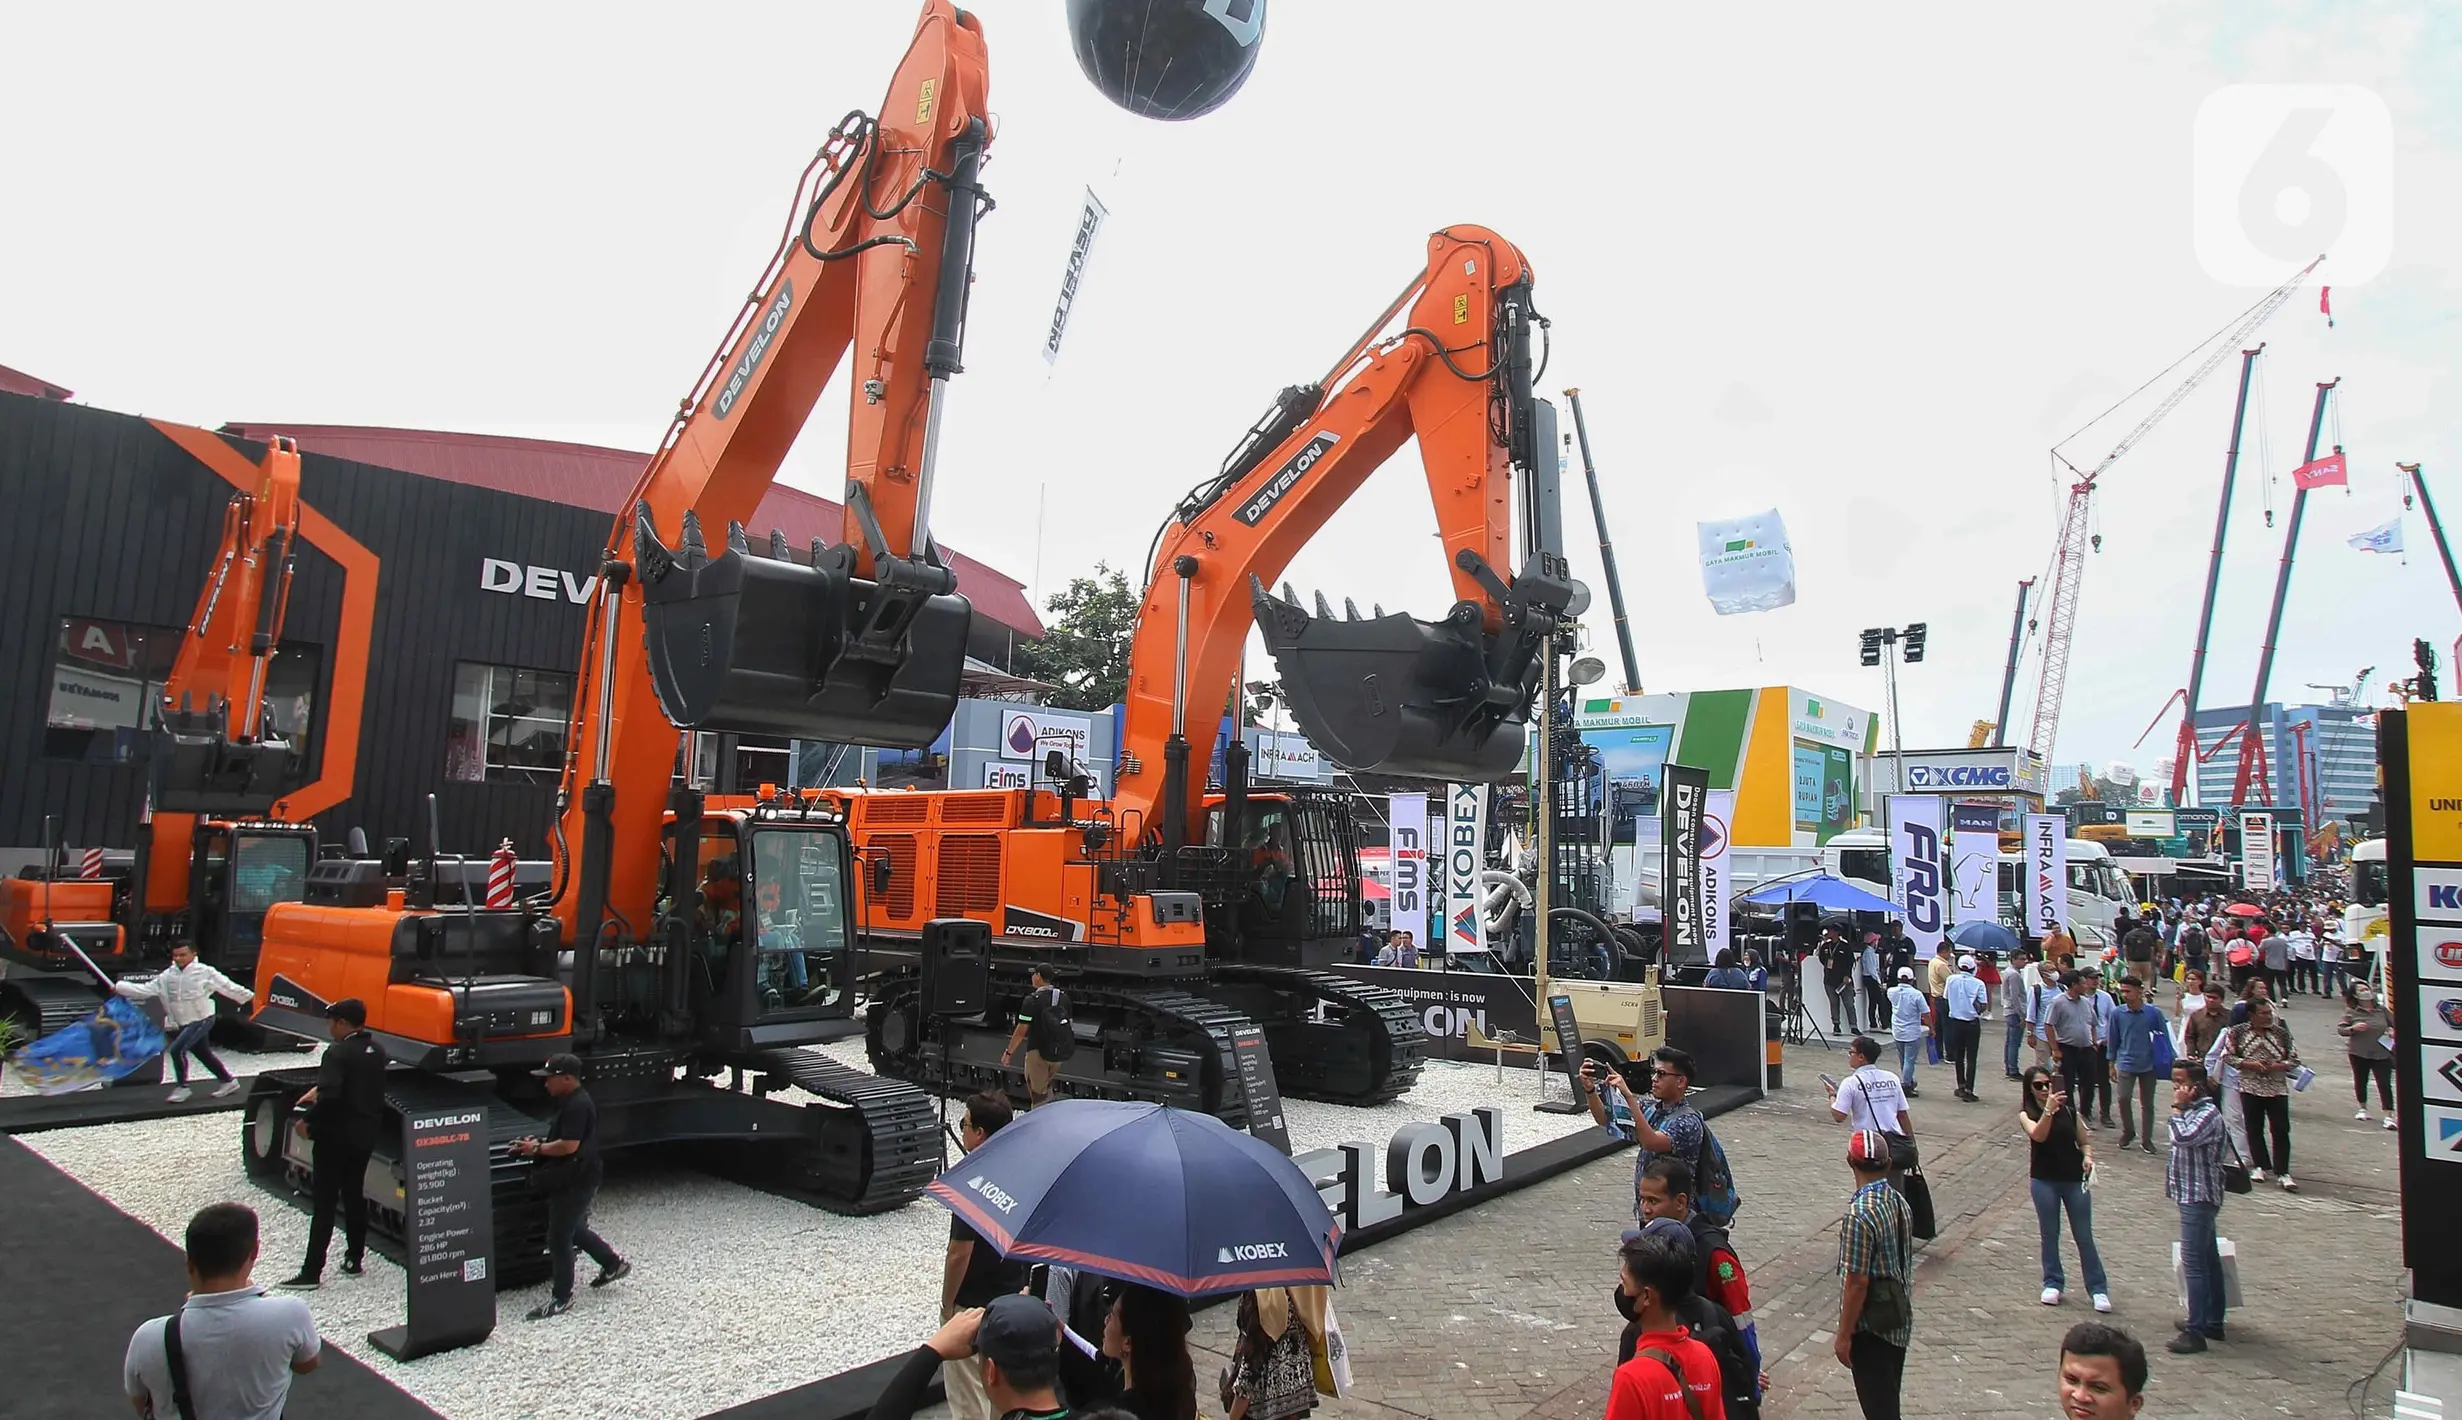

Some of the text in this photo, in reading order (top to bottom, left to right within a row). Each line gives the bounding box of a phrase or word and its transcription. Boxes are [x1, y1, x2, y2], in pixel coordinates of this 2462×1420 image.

[718, 292, 791, 413] DEVELON
[1245, 442, 1323, 522] DEVELON
[1724, 553, 1754, 563] MAKMUR
[1756, 549, 1778, 557] MOBIL
[481, 557, 608, 605] DEV
[201, 562, 229, 634] DEVELON
[1583, 717, 1620, 727] MAKMUR
[1622, 716, 1650, 725] MOBIL
[1041, 726, 1085, 740] ADIKONS
[1930, 766, 2011, 786] XCMG
[1692, 786, 1701, 818] Doosan
[1959, 818, 1993, 827] MAN
[1452, 783, 1478, 899] KOBEX
[1398, 827, 1426, 912] Fims
[1677, 784, 1693, 946] DEVELON
[1904, 821, 1941, 934] FRD
[1705, 866, 1717, 940] ADIKONS
[1450, 990, 1459, 1001] is
[1462, 993, 1485, 1003] now
[1235, 1027, 1260, 1037] DEVELON
[413, 1112, 481, 1130] DEVELON
[417, 1158, 454, 1171] Operating
[418, 1195, 443, 1206] Bucket
[979, 1180, 1018, 1215] KOBEX
[418, 1217, 436, 1227] 2.32
[419, 1226, 470, 1243] Engine Power
[436, 1240, 448, 1251] HP
[448, 1249, 466, 1260] rpm
[1233, 1242, 1288, 1261] KOBEX
[420, 1269, 458, 1284] Scan Here
